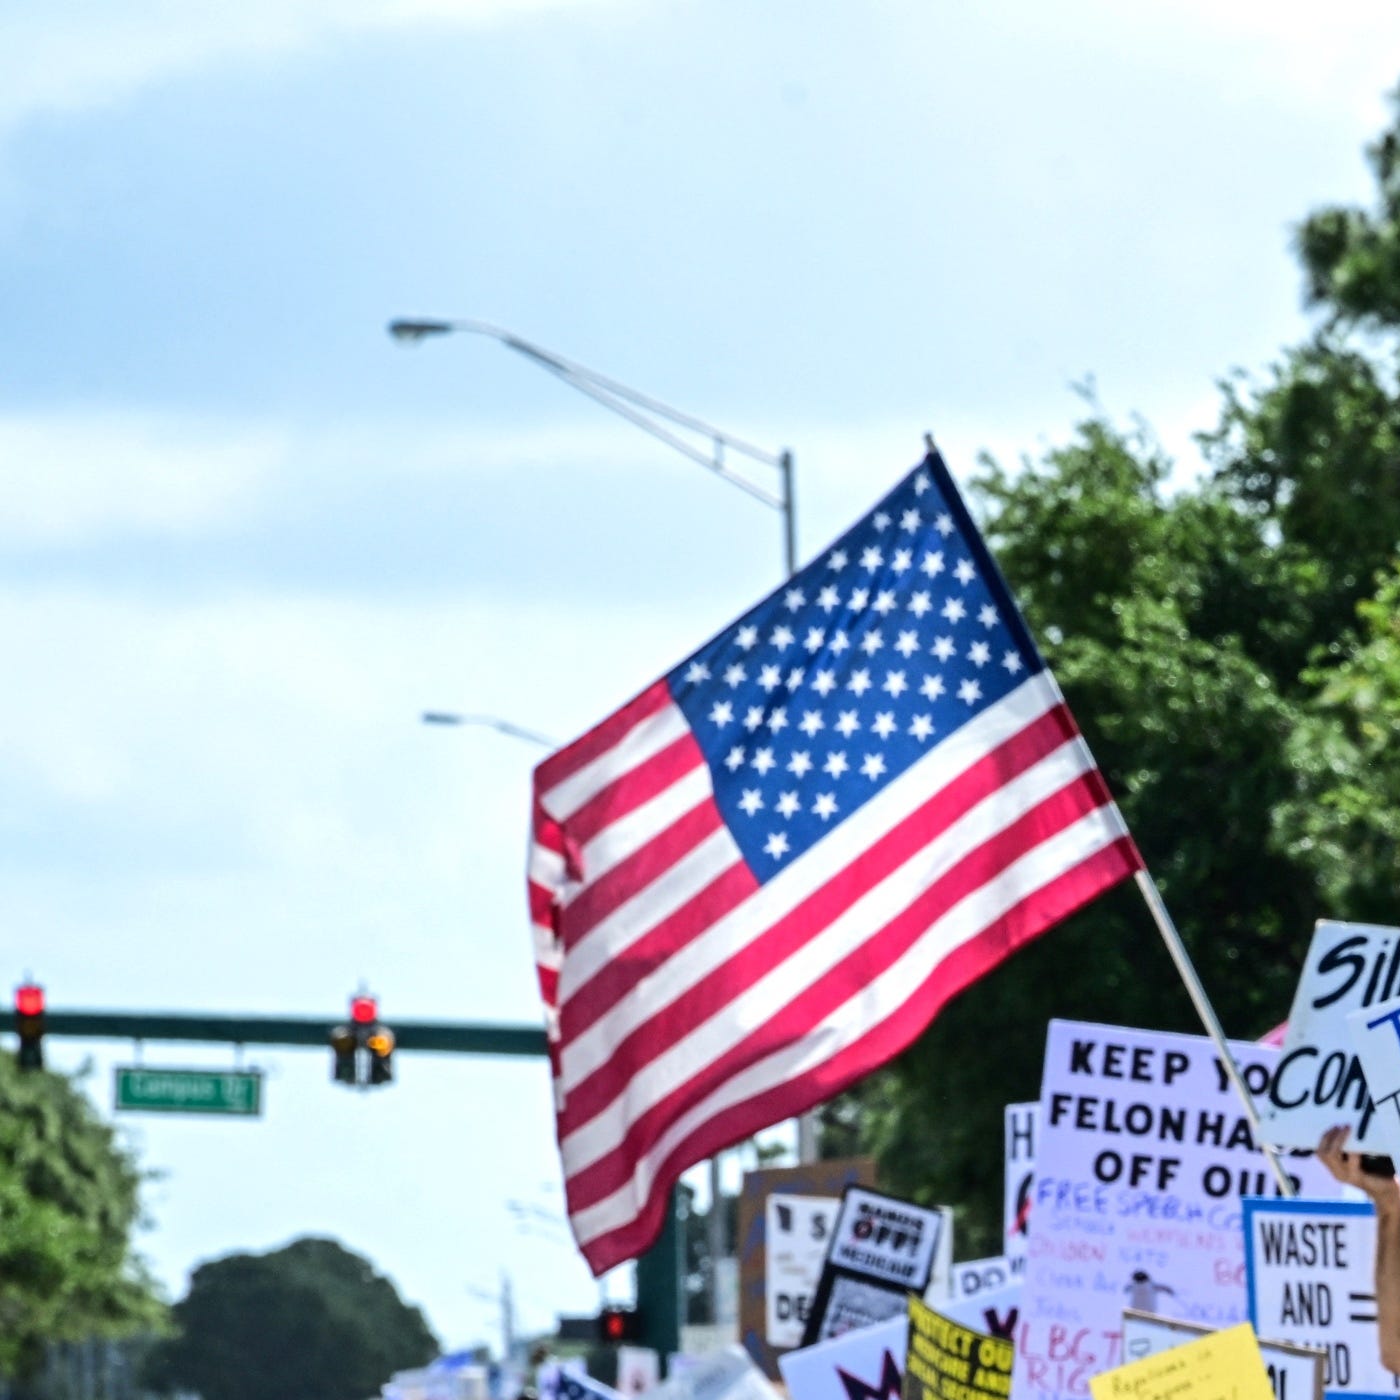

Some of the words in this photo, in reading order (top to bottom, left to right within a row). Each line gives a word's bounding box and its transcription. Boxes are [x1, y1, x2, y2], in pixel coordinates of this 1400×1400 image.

[1069, 1040, 1191, 1085] KEEP
[1049, 1093, 1187, 1143] FELON
[1093, 1150, 1181, 1192] OFF
[1260, 1222, 1349, 1269] WASTE
[1281, 1282, 1333, 1326] AND
